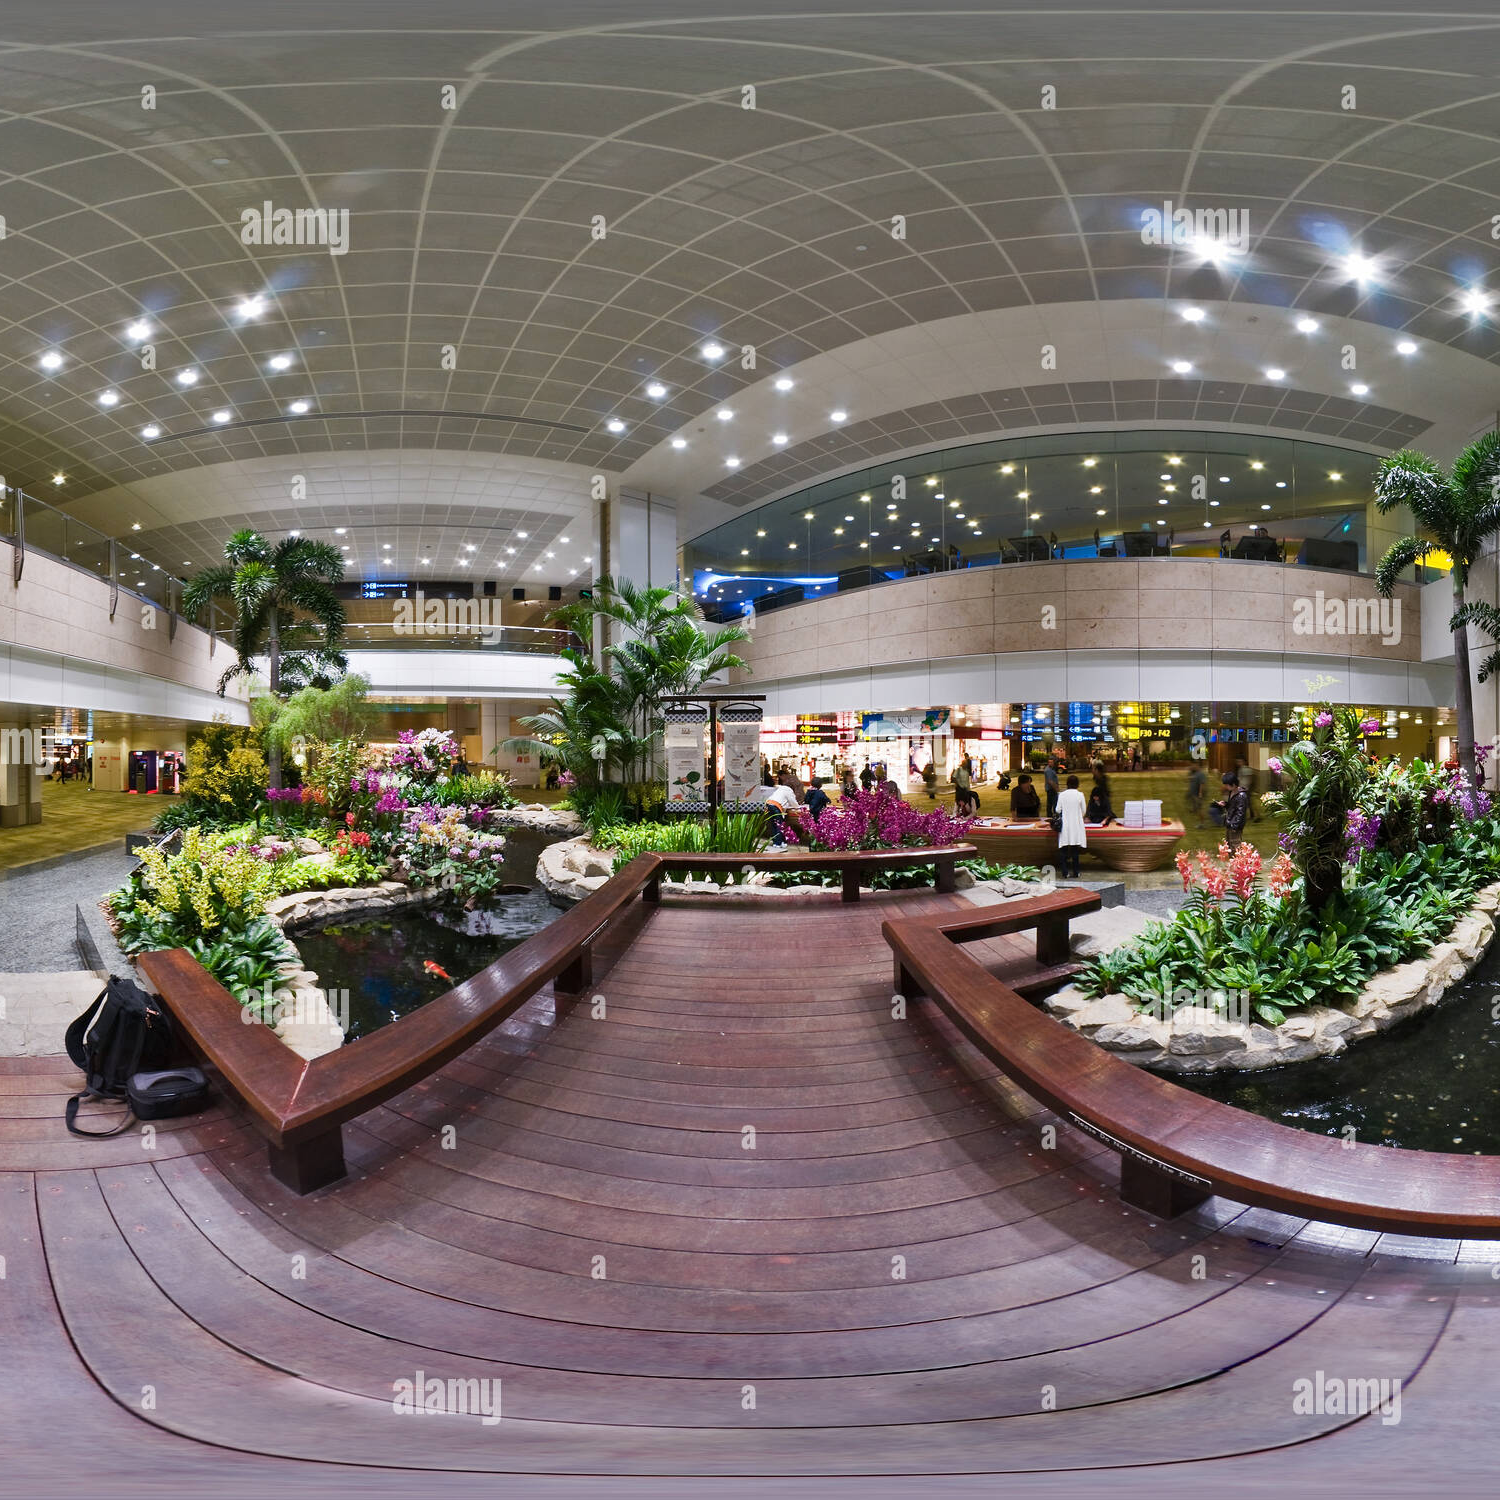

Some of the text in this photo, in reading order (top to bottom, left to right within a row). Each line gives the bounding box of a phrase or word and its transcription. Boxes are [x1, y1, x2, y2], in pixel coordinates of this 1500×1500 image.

[1139, 729, 1152, 737] F30
[1158, 729, 1171, 737] F42
[1074, 1117, 1200, 1184] Please Do Not Feed The Fish
